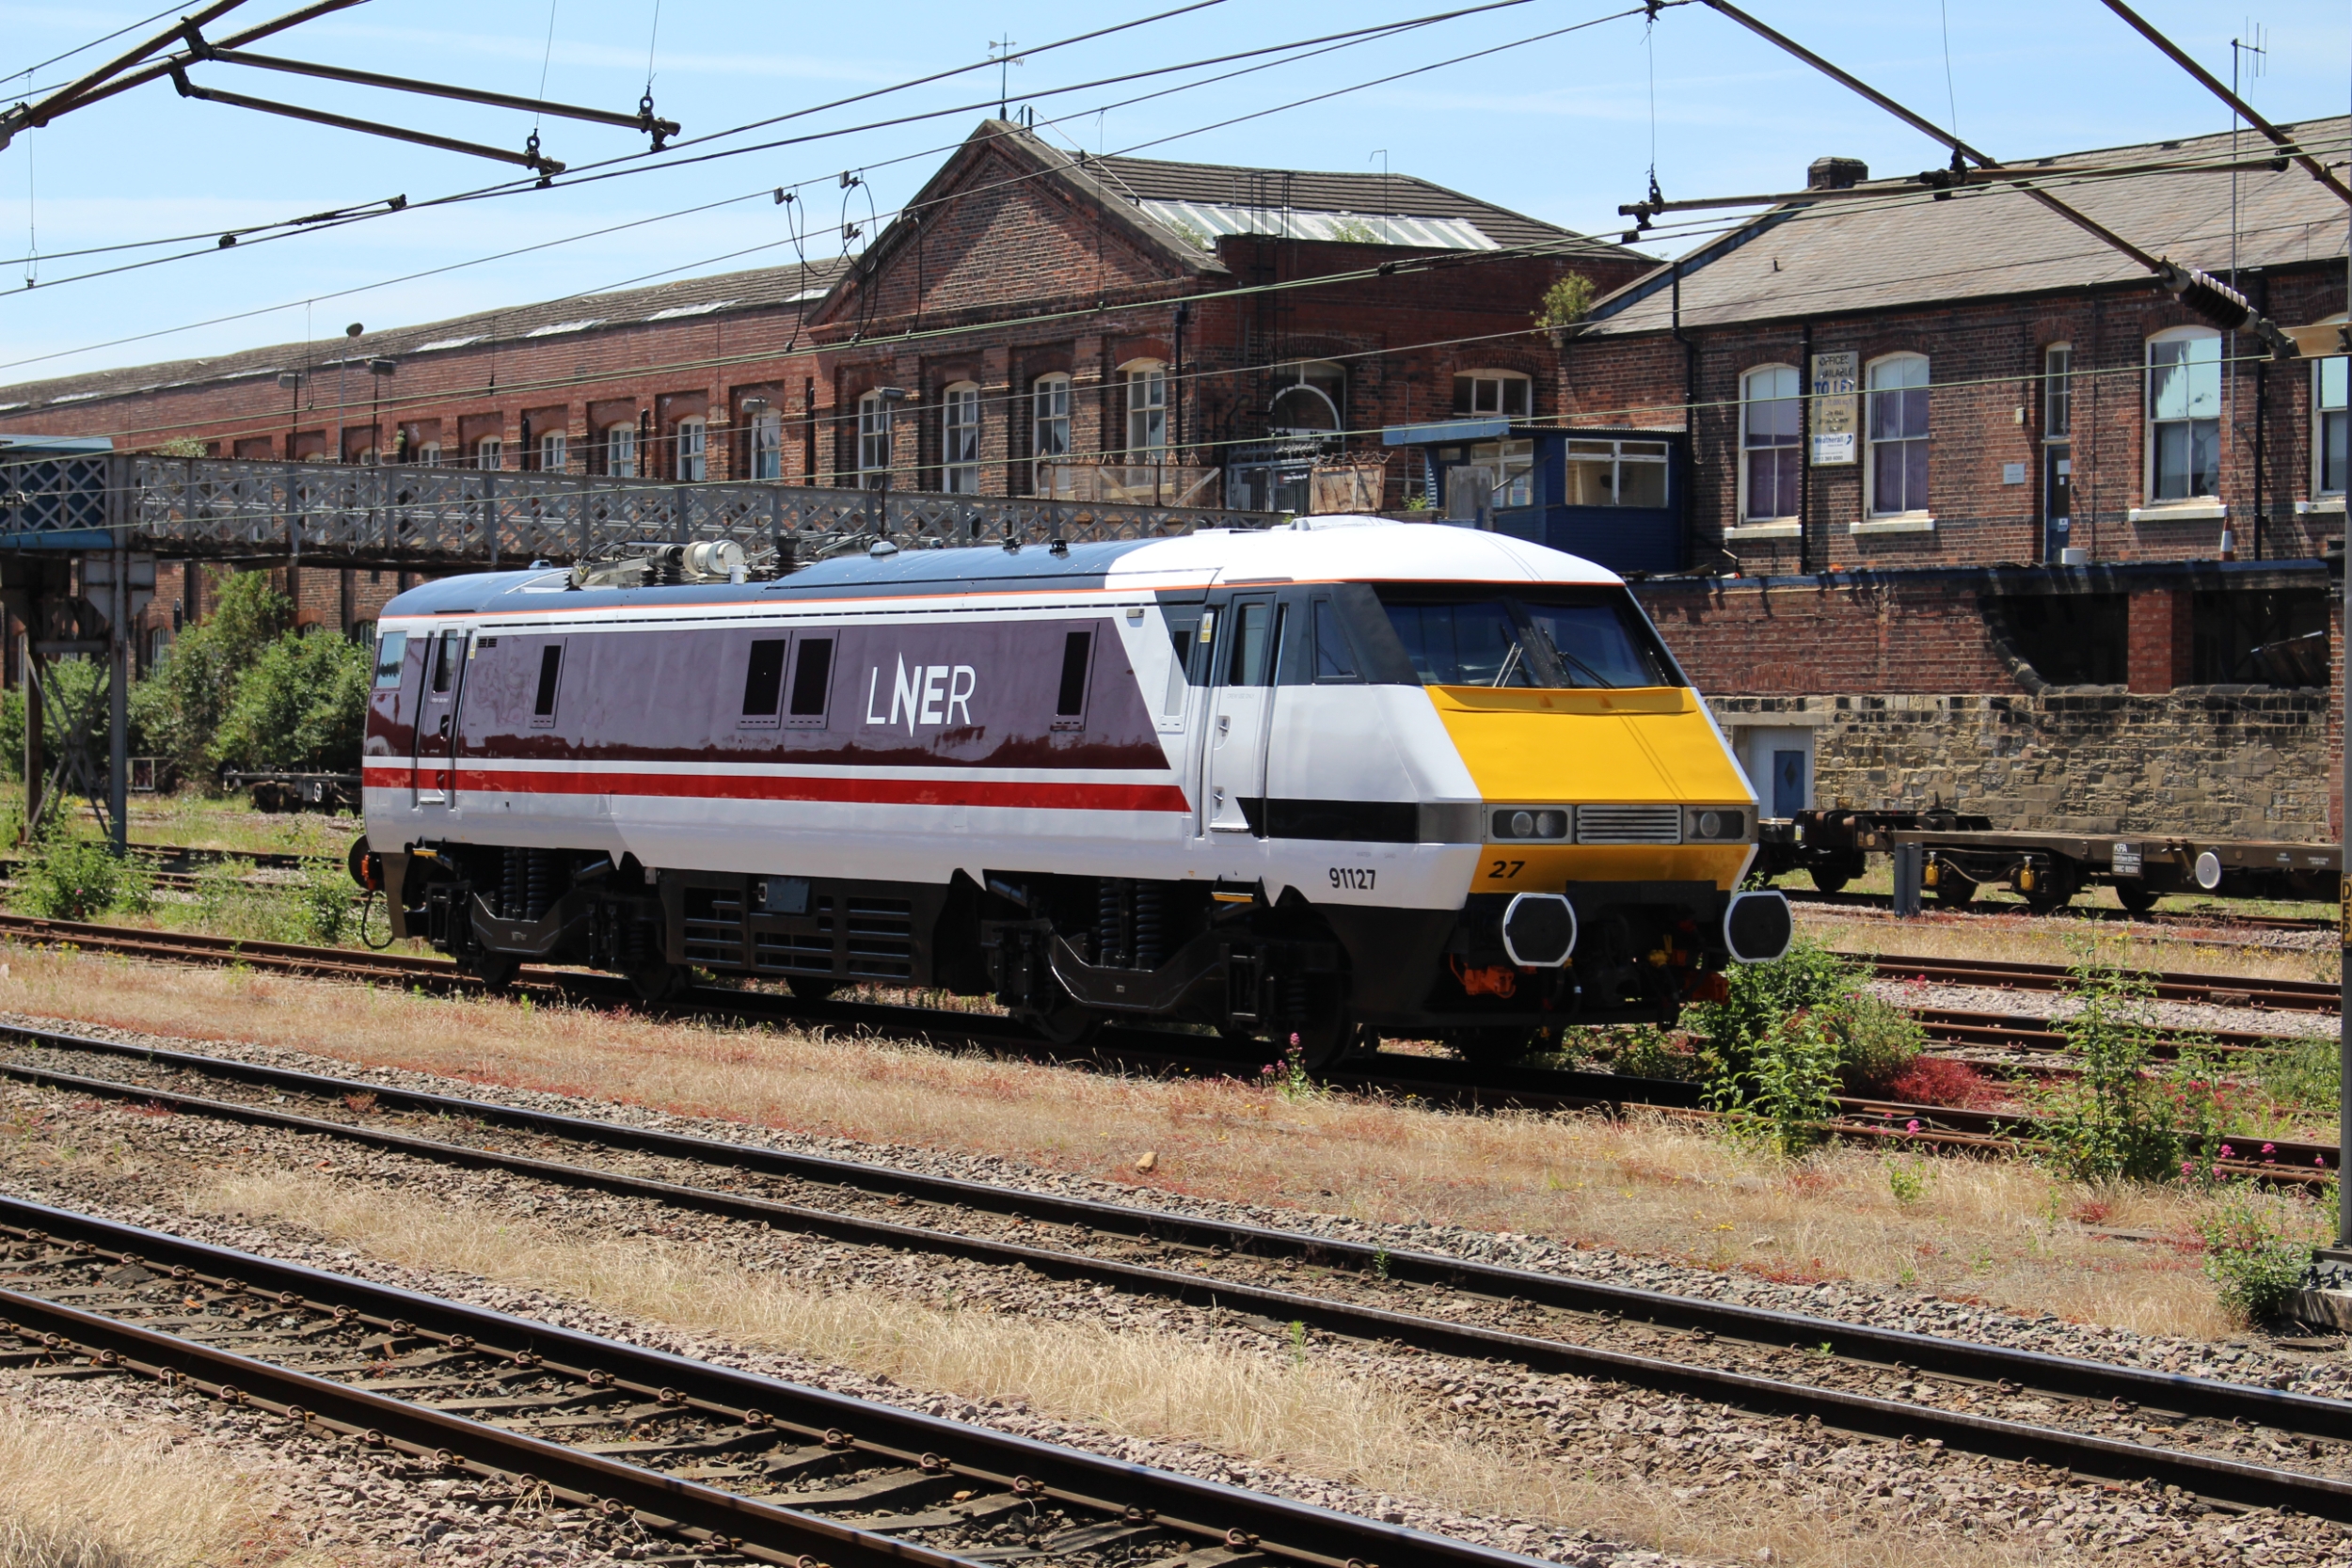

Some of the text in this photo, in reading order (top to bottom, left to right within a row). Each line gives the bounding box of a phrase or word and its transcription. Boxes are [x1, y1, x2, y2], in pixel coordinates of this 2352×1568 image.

[1819, 355, 1849, 366] OFFICES
[1814, 380, 1830, 394] TO
[866, 652, 976, 737] LNER
[2113, 843, 2127, 853] KFA
[1488, 861, 1525, 879] 27
[1328, 866, 1376, 891] 91127
